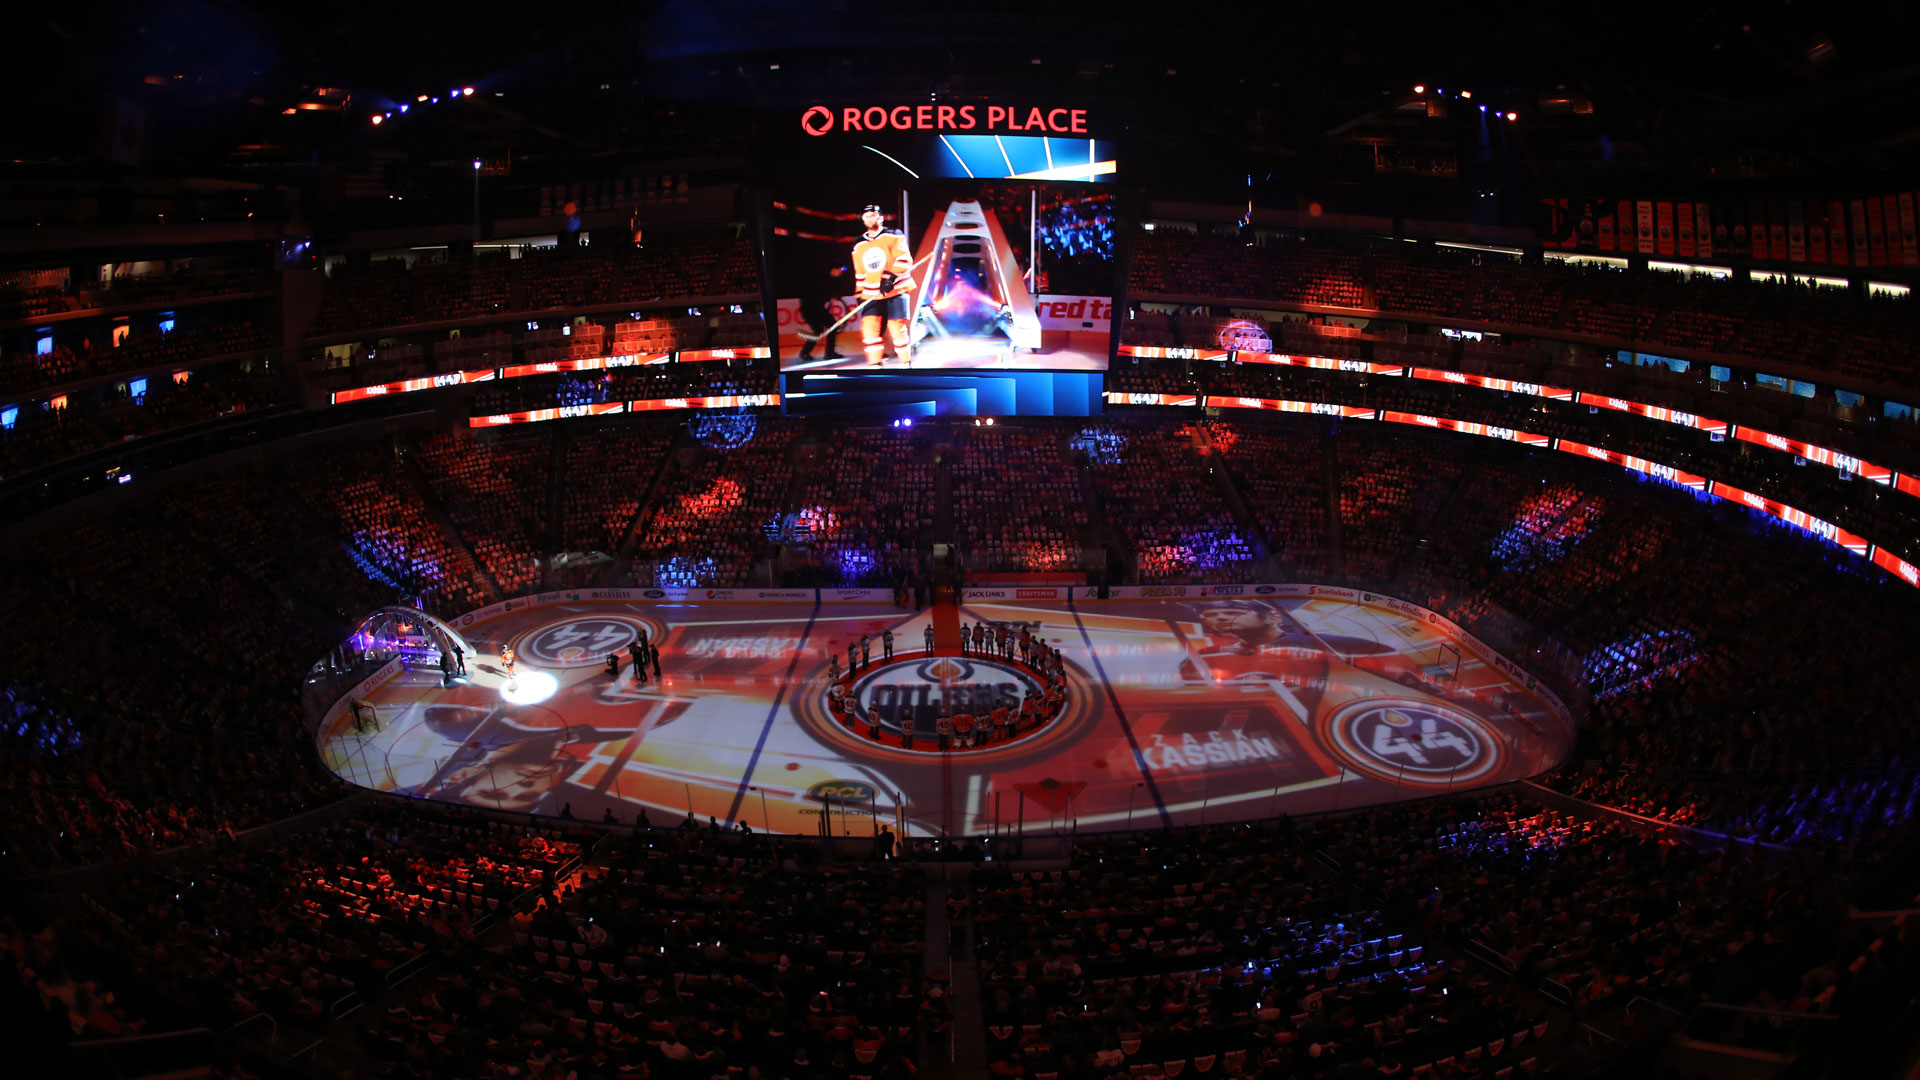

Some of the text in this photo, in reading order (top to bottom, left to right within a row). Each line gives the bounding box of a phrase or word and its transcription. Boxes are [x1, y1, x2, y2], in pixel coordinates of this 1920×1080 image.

[843, 105, 1088, 133] ROGERS PLACE
[1038, 299, 1087, 319] red
[1141, 587, 1186, 597] PIZZA 73
[1318, 588, 1355, 598] Scotiabank
[1386, 598, 1400, 610] Tim
[1400, 602, 1426, 620] Hortons
[370, 664, 394, 686] ROGERS
[1151, 728, 1248, 747] ZACK
[1372, 718, 1474, 765] 44
[1135, 737, 1279, 772] KASSIAN
[818, 786, 867, 798] PCL
[798, 808, 882, 816] CONTRUCTION
